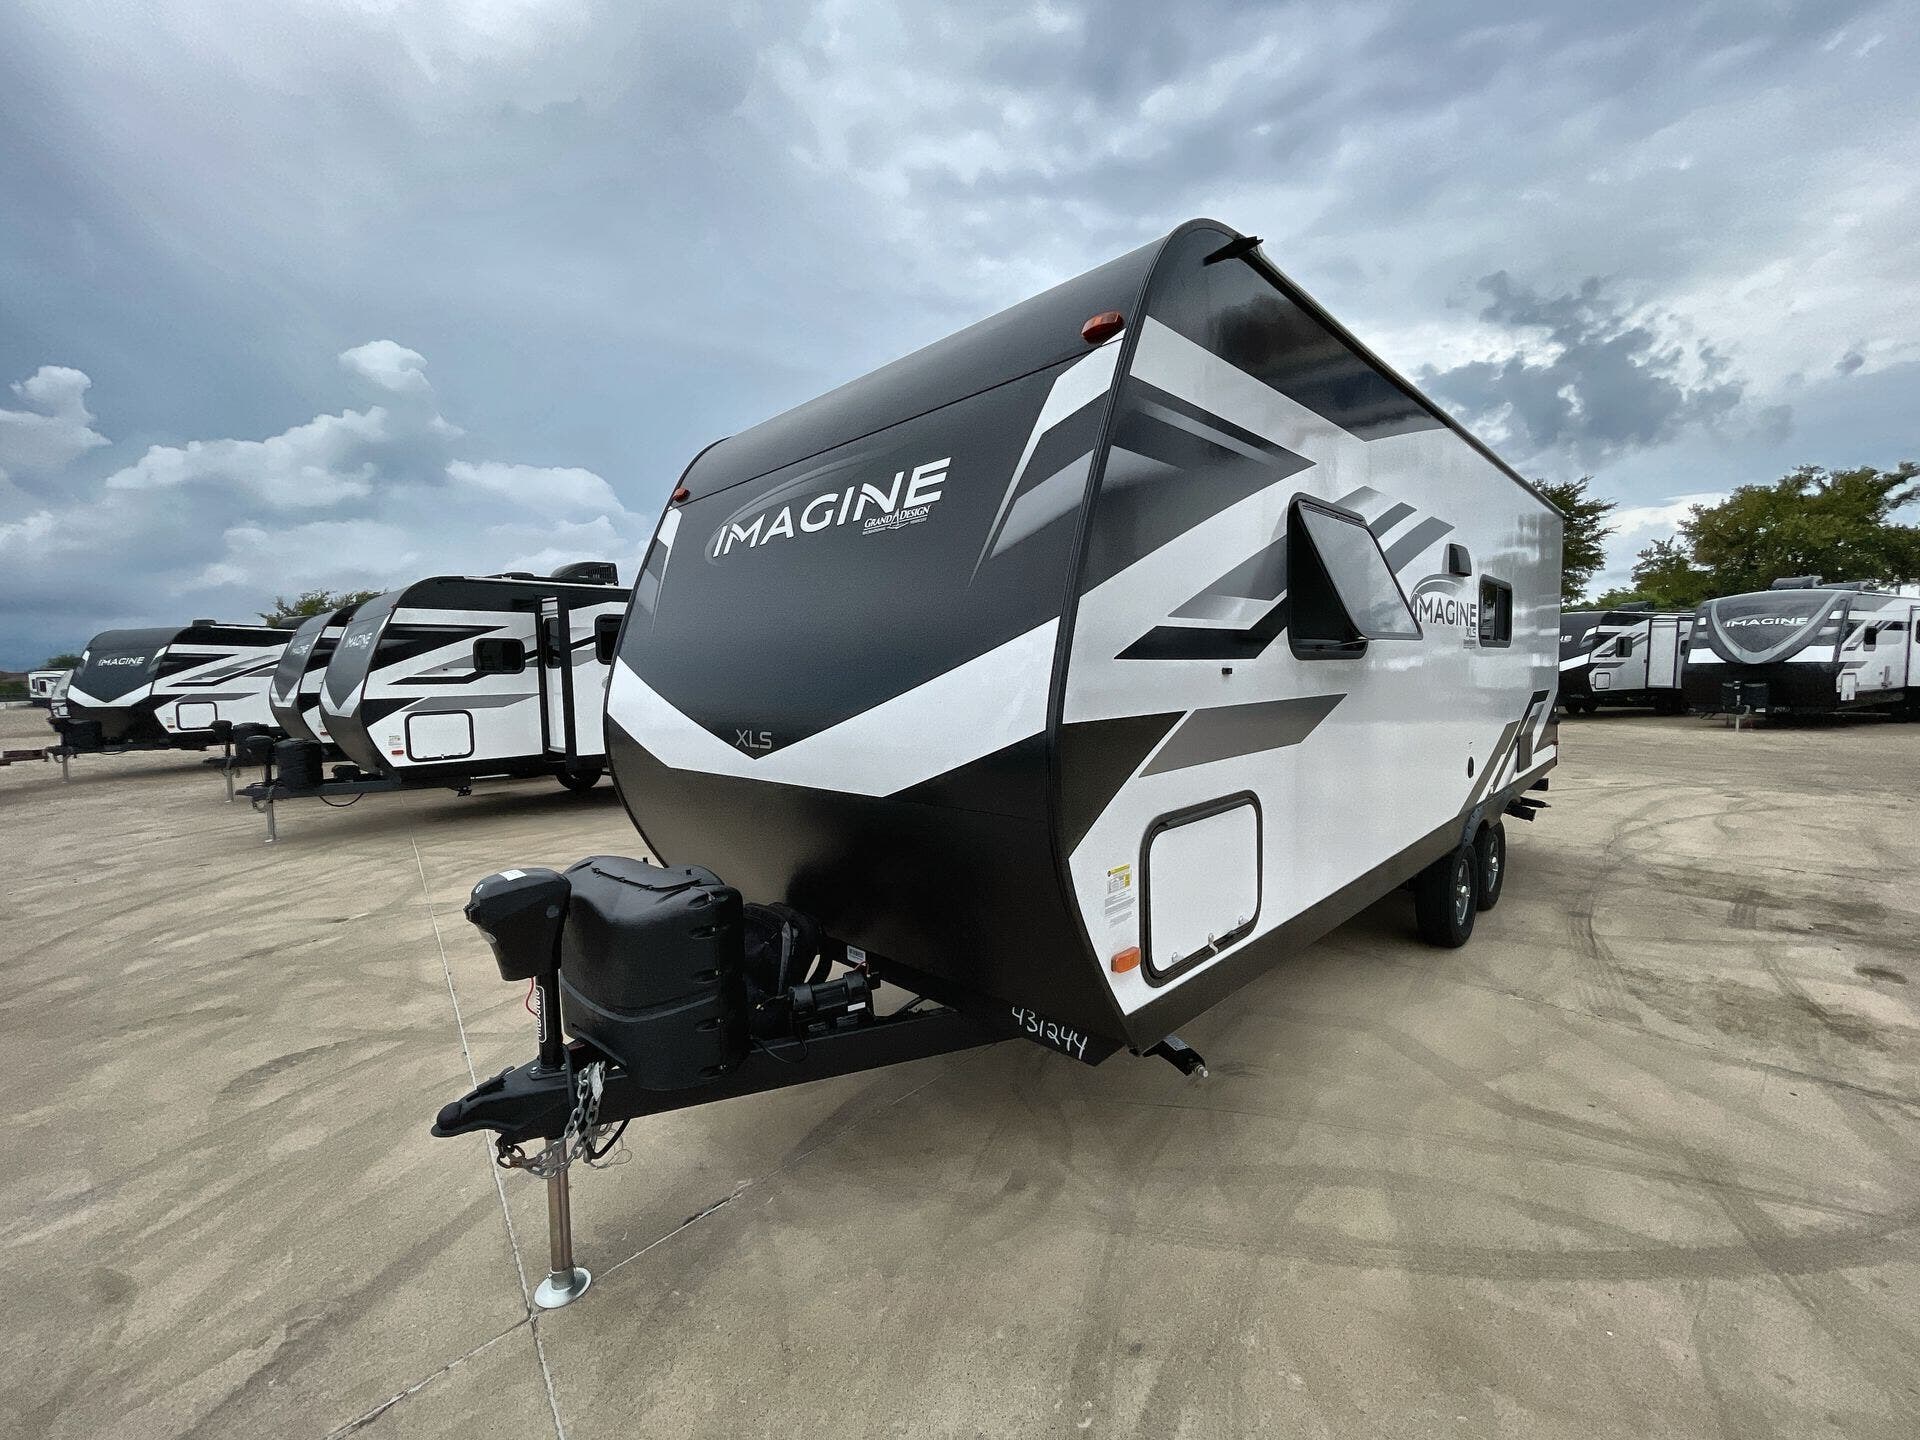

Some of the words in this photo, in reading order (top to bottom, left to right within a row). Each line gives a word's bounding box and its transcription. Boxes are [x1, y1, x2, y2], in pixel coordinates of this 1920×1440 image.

[713, 457, 951, 557] IMAGINE
[864, 514, 893, 528] GRAND
[900, 504, 932, 520] DESIGN
[1412, 594, 1477, 628] IMAGINE
[1726, 617, 1809, 628] IMAGINE
[98, 656, 146, 667] IMAGINE
[735, 728, 772, 750] XLS
[1011, 1006, 1088, 1060] 431244
